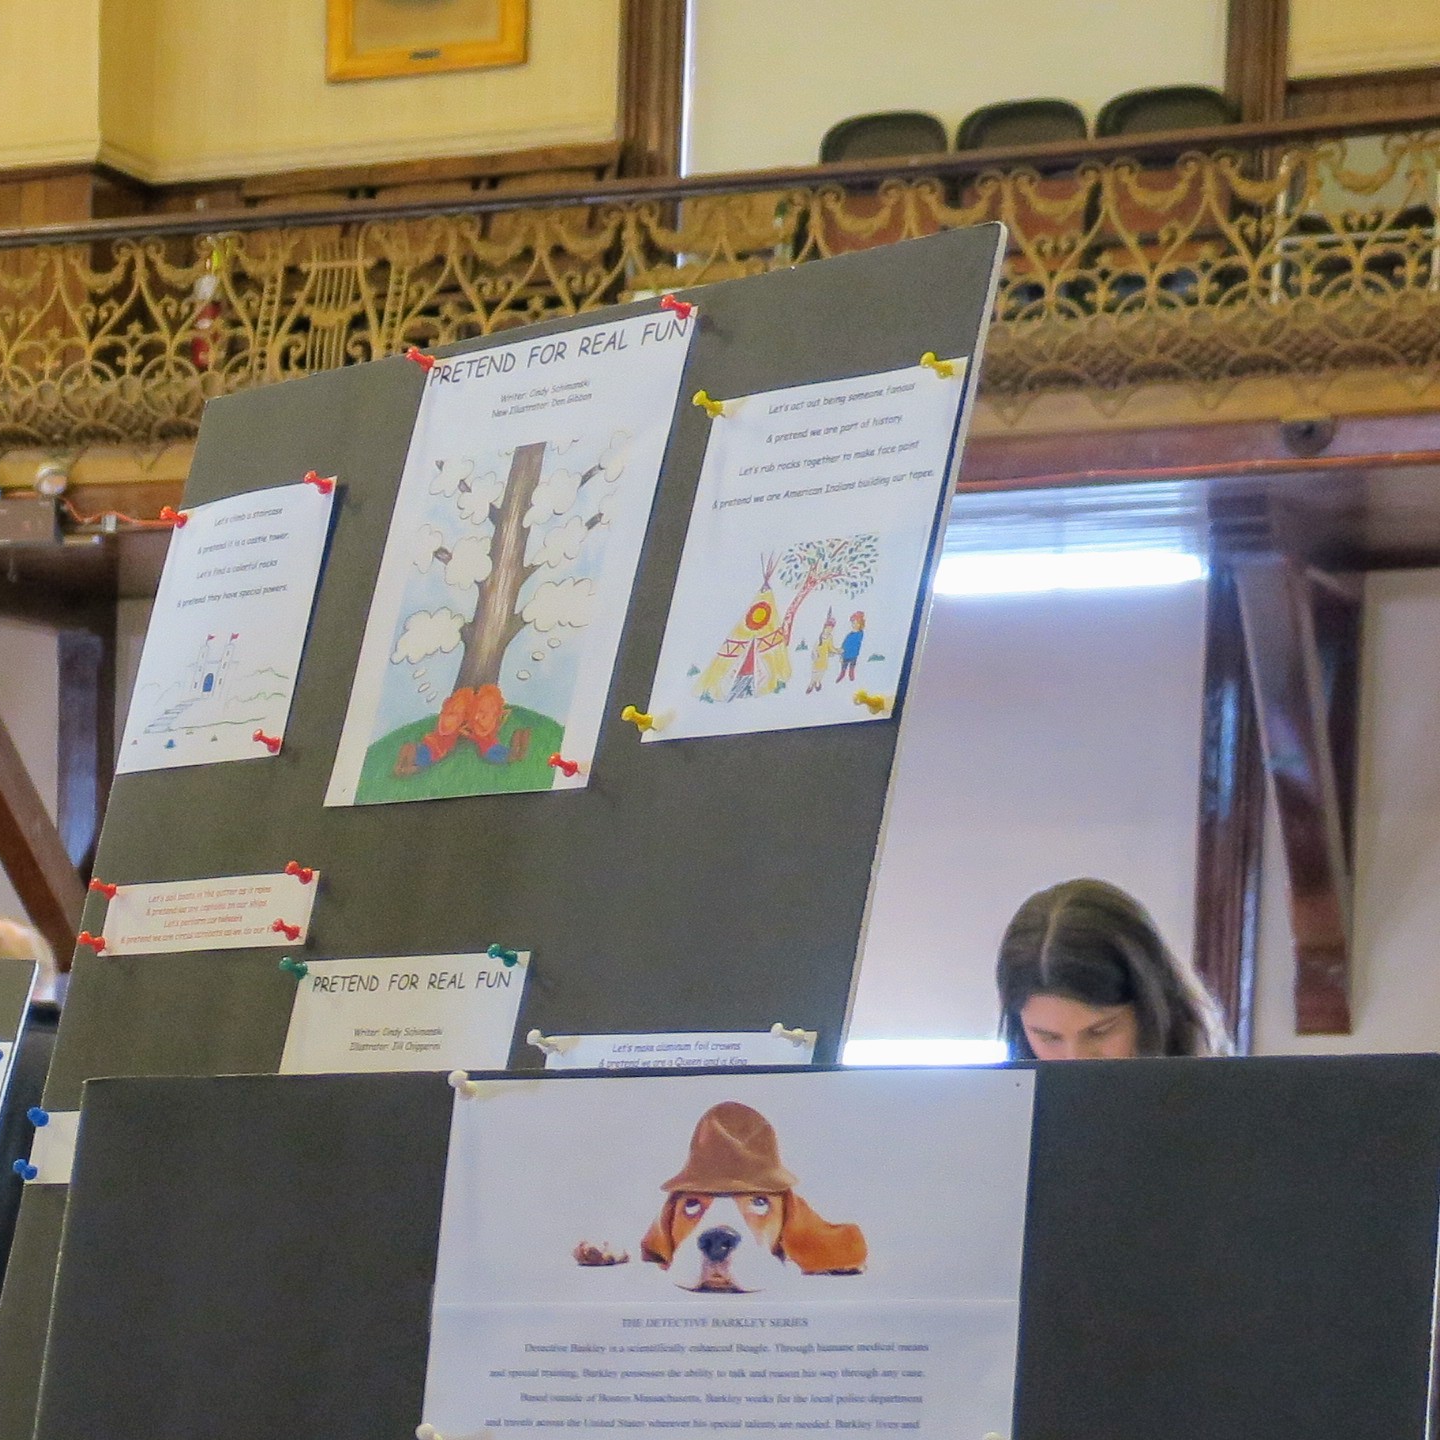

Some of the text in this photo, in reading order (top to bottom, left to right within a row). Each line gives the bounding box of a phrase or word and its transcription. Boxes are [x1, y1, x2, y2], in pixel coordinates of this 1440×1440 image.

[430, 318, 688, 386] PRETEND FOR REAL FUN
[312, 971, 511, 992] PRETEND FOR REAL FUN
[622, 1318, 808, 1328] THE DETECTIVE BARKLEY SERIES
